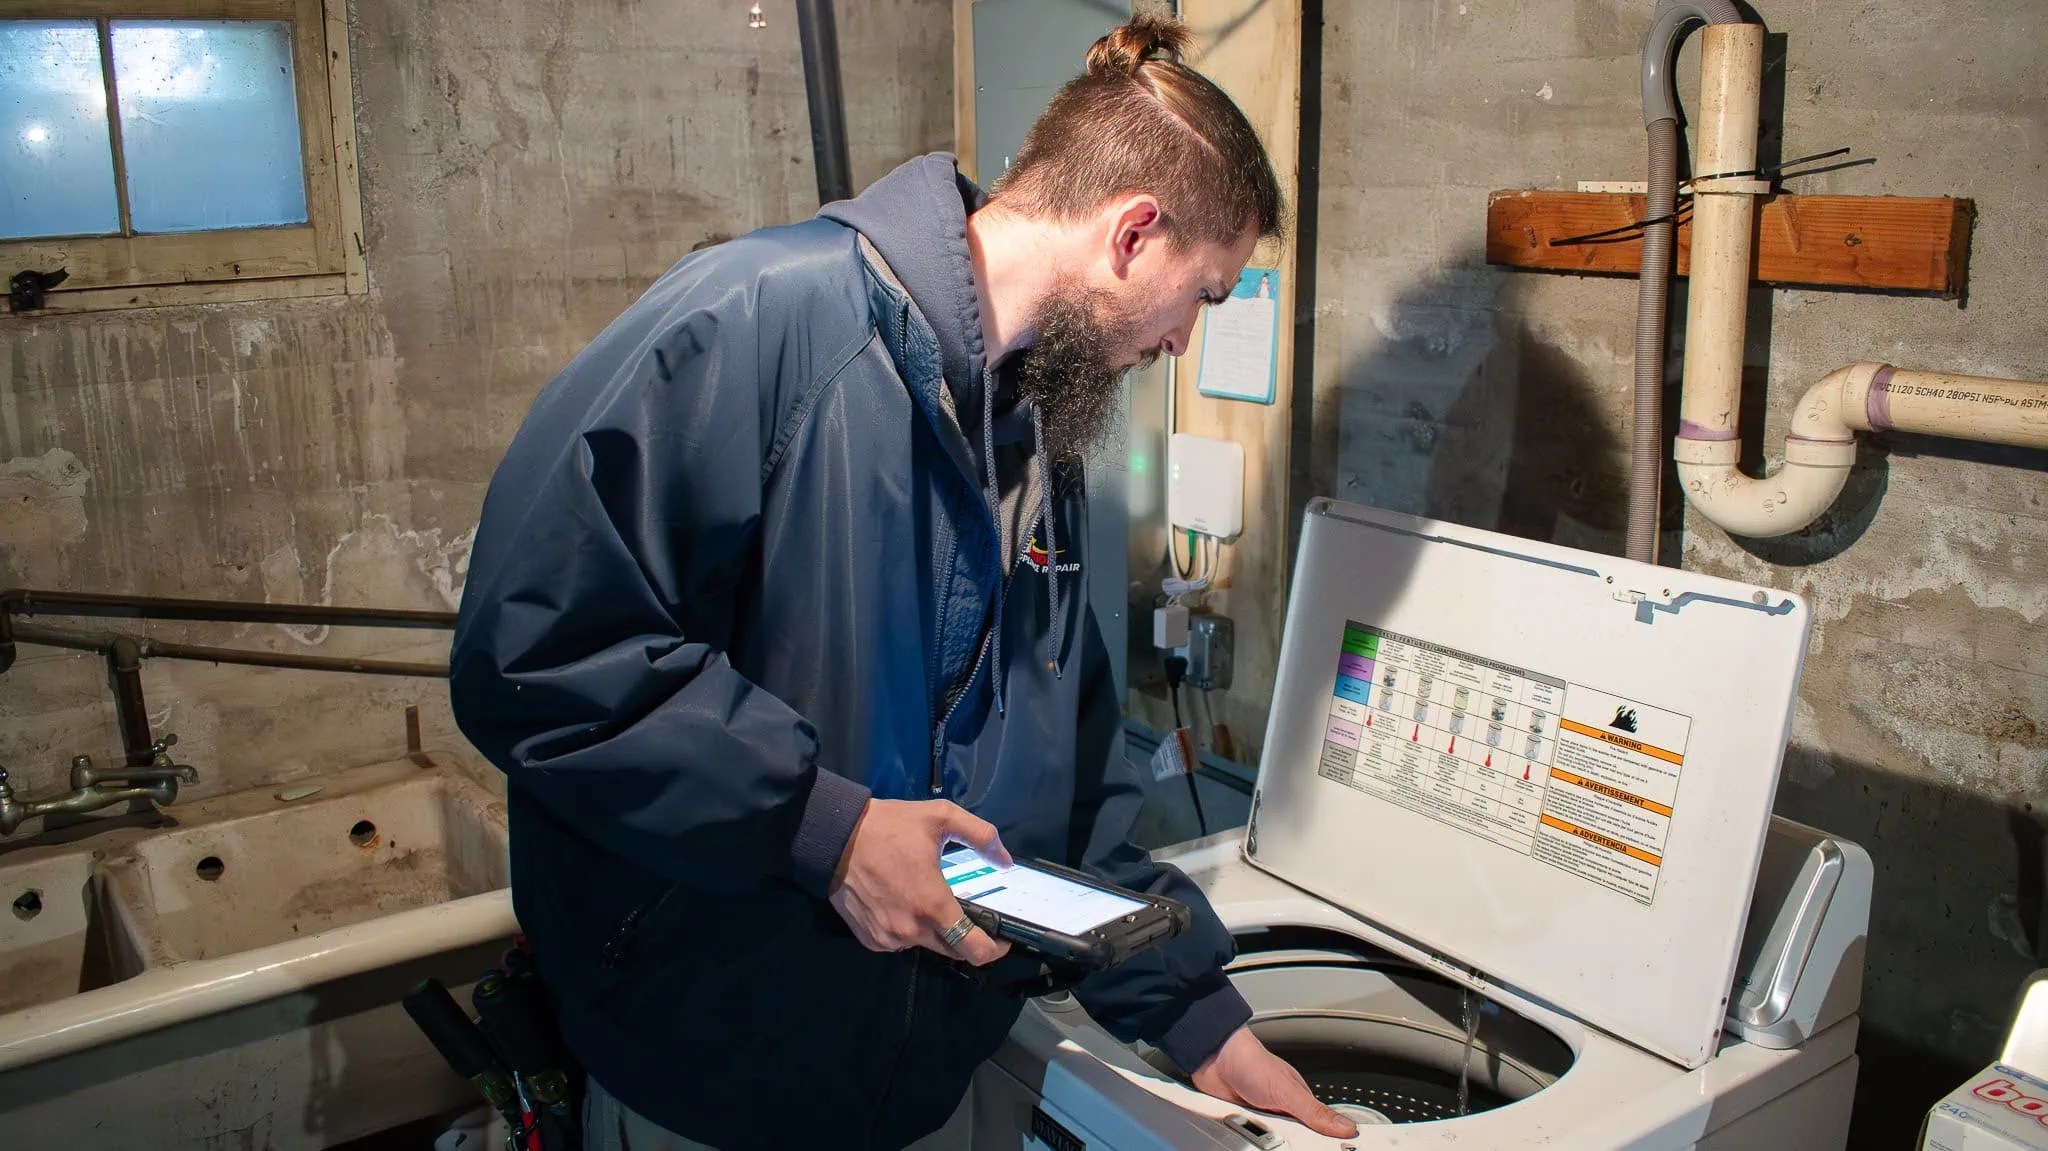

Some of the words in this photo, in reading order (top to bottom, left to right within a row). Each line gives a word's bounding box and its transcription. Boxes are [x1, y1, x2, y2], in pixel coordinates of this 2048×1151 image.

[1914, 386, 1945, 398] SCH40
[1945, 389, 1982, 402] 280PSI
[1041, 563, 1080, 574] RPAIR
[1608, 735, 1642, 751] WARNING
[1585, 780, 1645, 807] AVERTISSEMENT
[1580, 829, 1627, 853] ADVERTENCIA
[1939, 1103, 1968, 1119] 240
